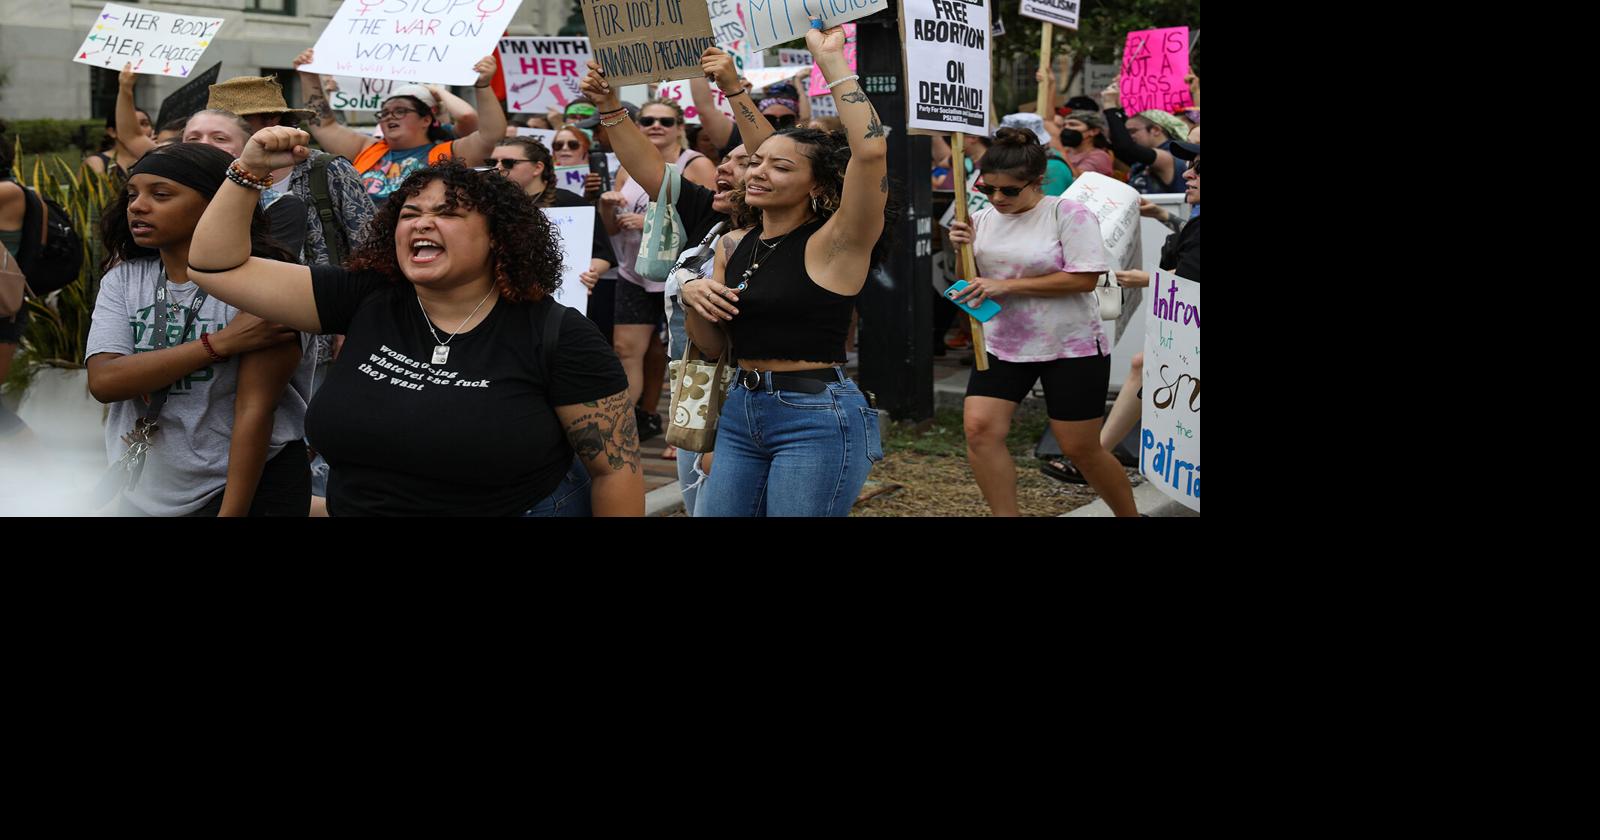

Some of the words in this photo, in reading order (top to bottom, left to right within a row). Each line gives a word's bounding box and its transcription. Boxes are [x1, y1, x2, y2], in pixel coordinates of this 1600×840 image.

[593, 4, 624, 38] FOR
[667, 0, 684, 25] OF
[711, 0, 732, 19] CE
[933, 0, 968, 24] FREE
[122, 13, 159, 32] HER
[171, 18, 213, 37] BODY
[348, 19, 386, 35] THE
[394, 19, 441, 35] WAR
[450, 20, 484, 37] ON
[715, 21, 744, 43] HTS
[914, 19, 985, 50] ABORTION
[102, 35, 142, 57] HER
[150, 43, 201, 61] CHOICE
[356, 42, 449, 62] WOMEN
[500, 39, 528, 54] I'M
[532, 40, 589, 55] WITH
[1162, 32, 1183, 53] IS
[519, 57, 579, 77] HER
[594, 42, 651, 78] UNWANTED
[781, 53, 814, 65] UNDE
[1121, 56, 1151, 77] NOT
[1161, 54, 1173, 75] A
[865, 76, 896, 85] 25210
[946, 60, 965, 84] ON
[919, 81, 983, 111] DEMAND!
[1121, 75, 1171, 96] CLASS
[1159, 321, 1174, 349] but
[379, 344, 420, 369] women
[358, 363, 387, 381] they
[390, 377, 425, 391] want
[369, 353, 424, 381] whatever
[427, 375, 450, 385] the
[454, 379, 490, 388] fuck
[1176, 420, 1193, 440] the
